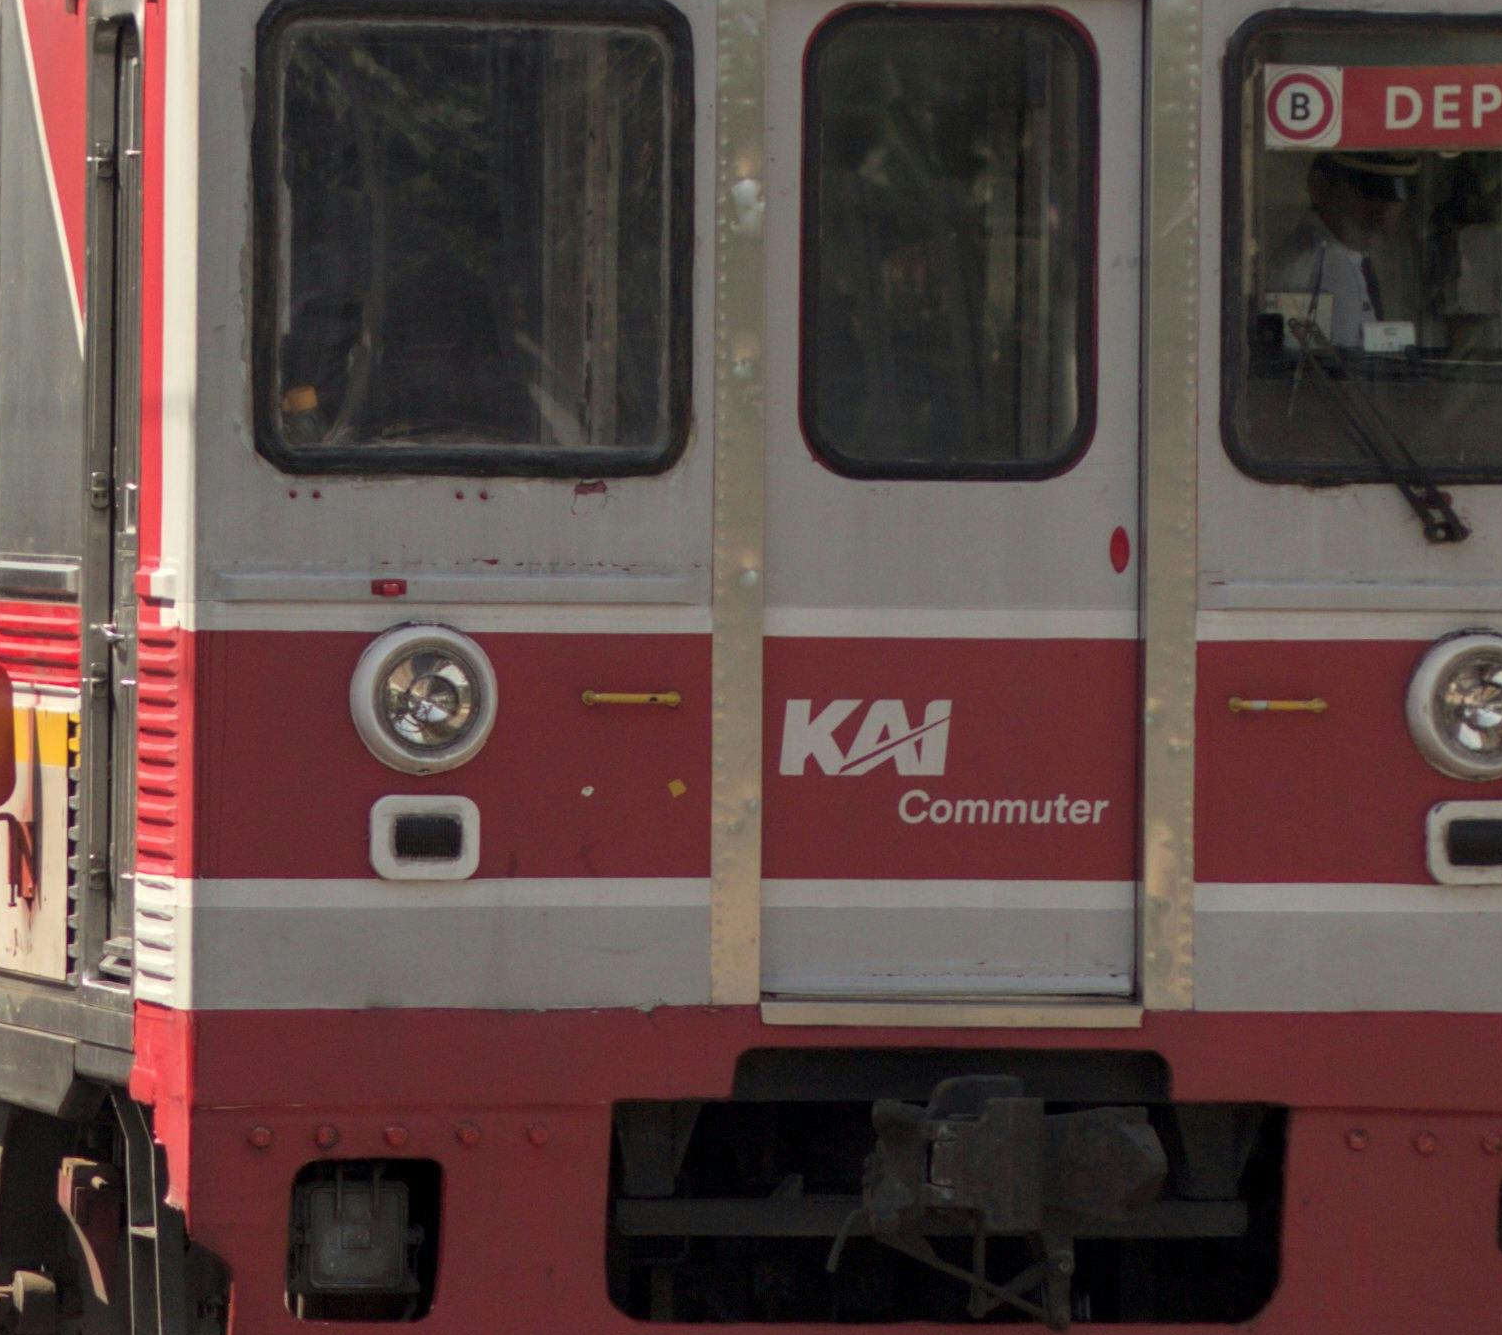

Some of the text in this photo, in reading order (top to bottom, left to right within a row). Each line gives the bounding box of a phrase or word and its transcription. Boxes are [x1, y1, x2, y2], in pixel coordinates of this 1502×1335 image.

[1289, 92, 1311, 121] B
[779, 699, 952, 776] KAI
[898, 789, 1109, 824] Commuter
